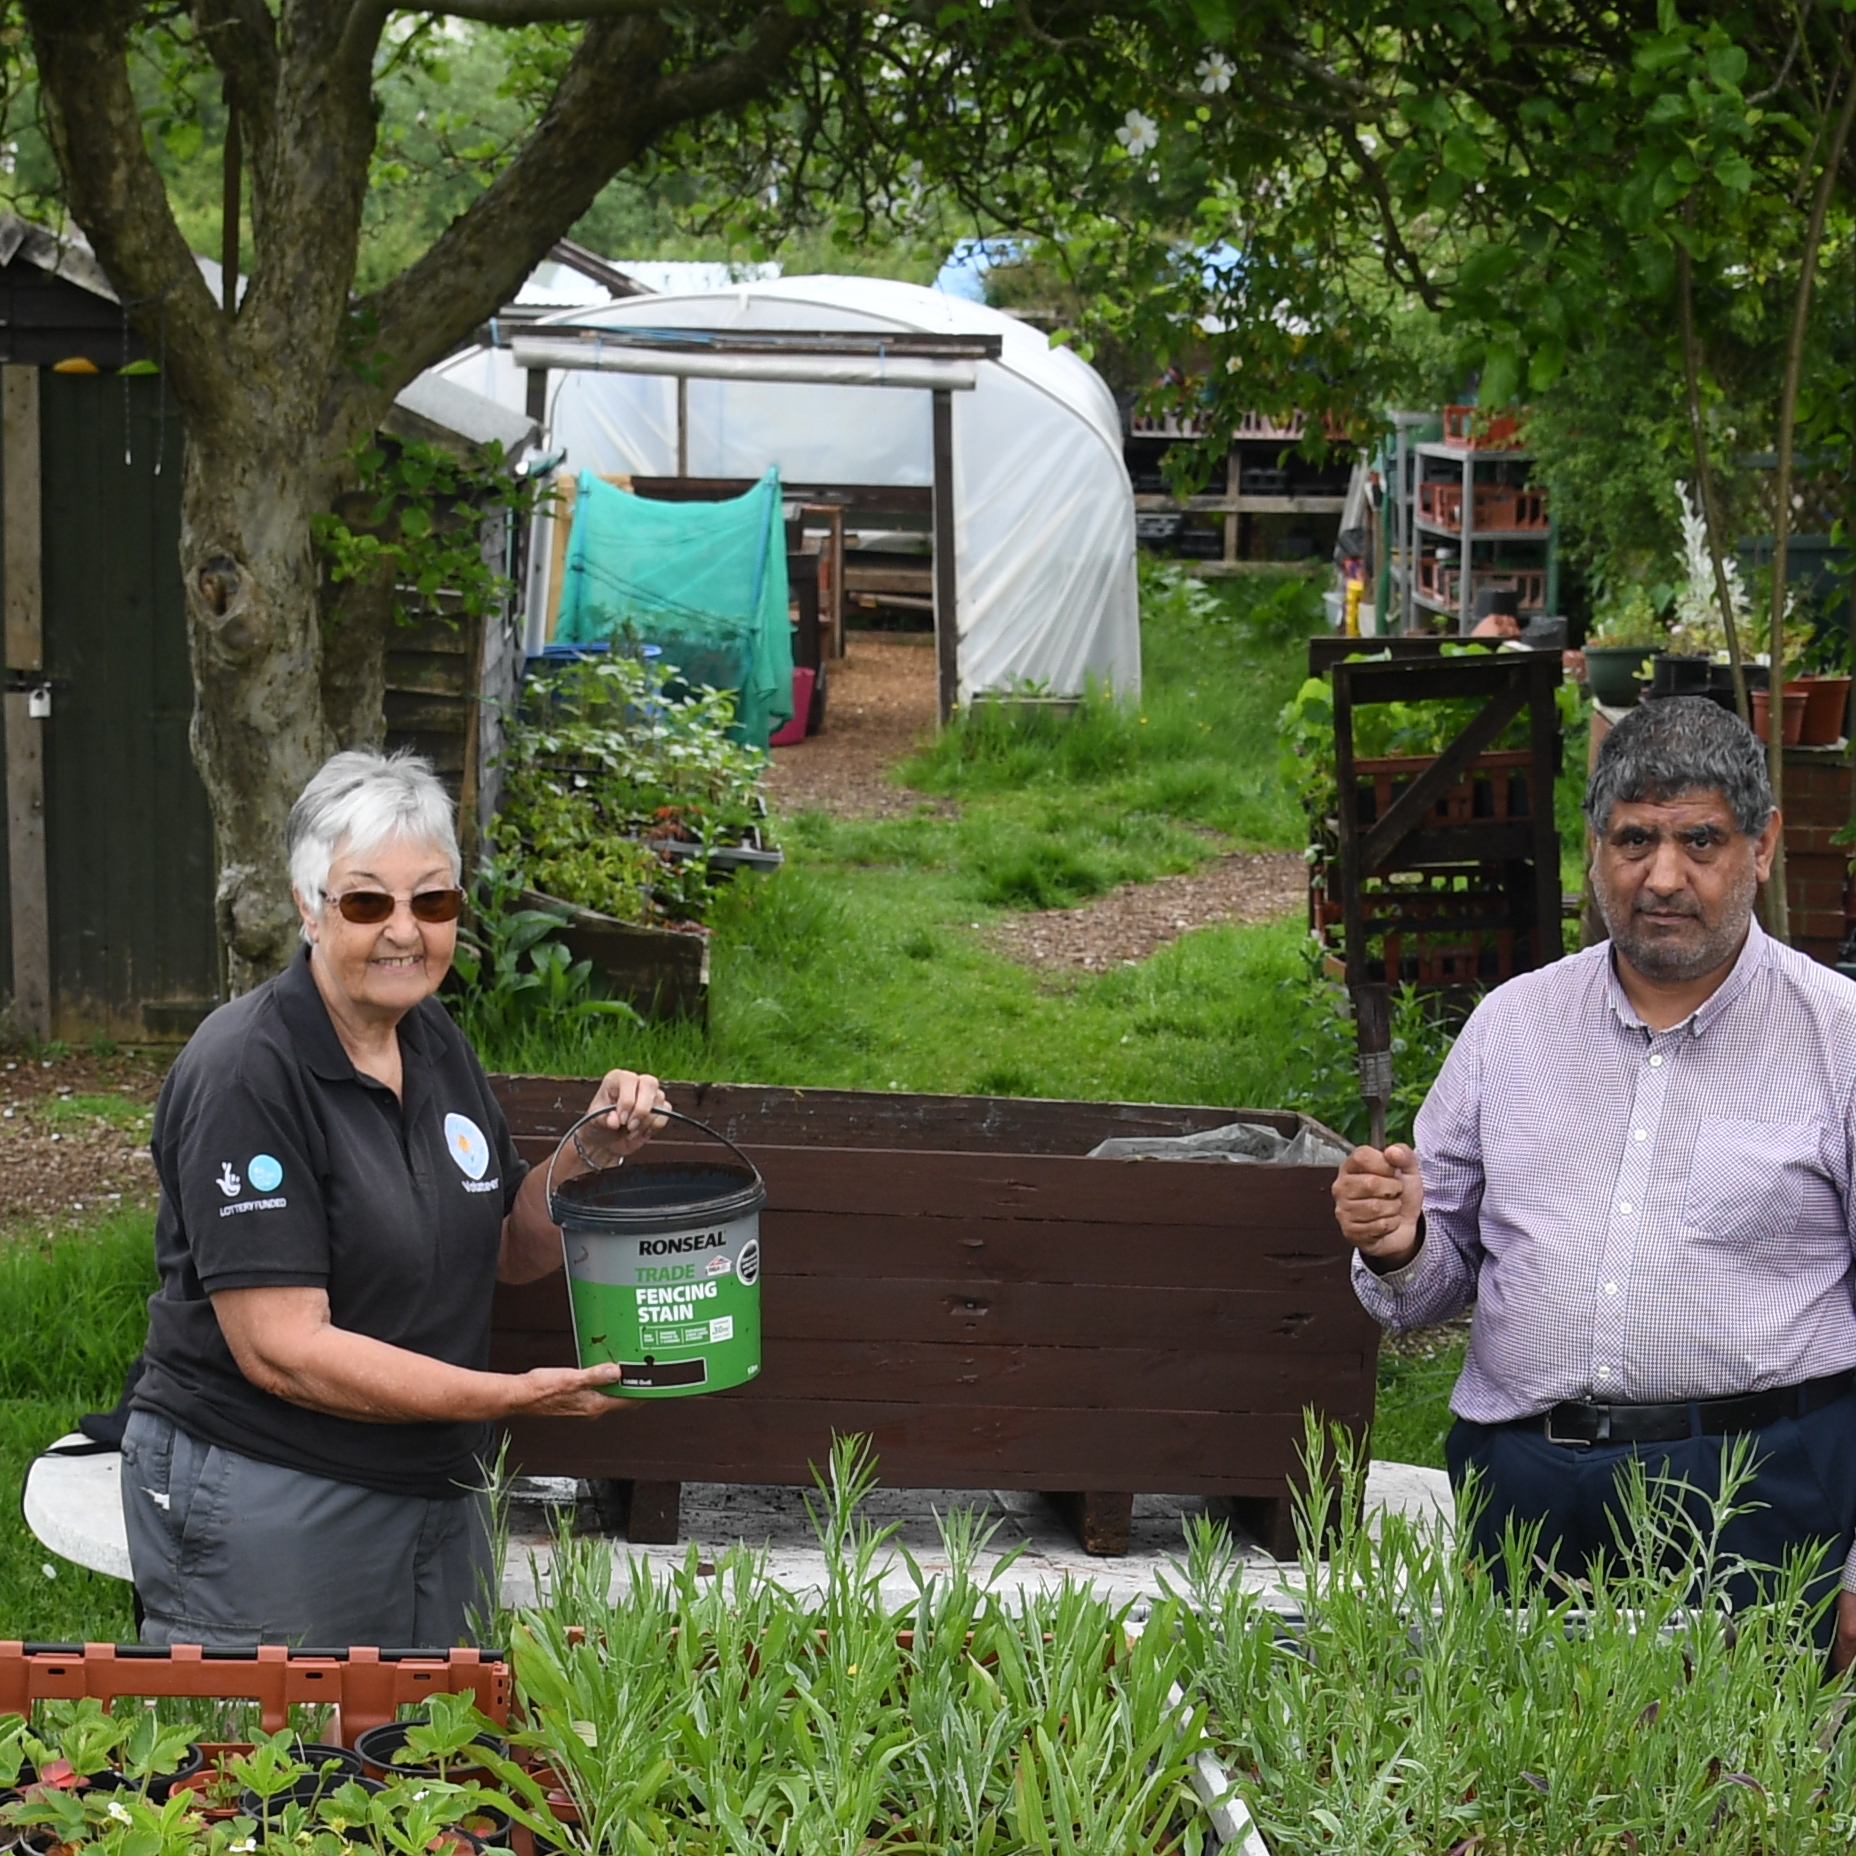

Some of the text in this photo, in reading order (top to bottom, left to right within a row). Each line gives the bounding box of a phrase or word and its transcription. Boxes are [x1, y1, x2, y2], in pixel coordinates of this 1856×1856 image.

[639, 1231, 726, 1256] RONSEAL
[635, 1264, 695, 1282] TRADE
[635, 1281, 717, 1305] FENCING
[638, 1303, 693, 1323] STAIN
